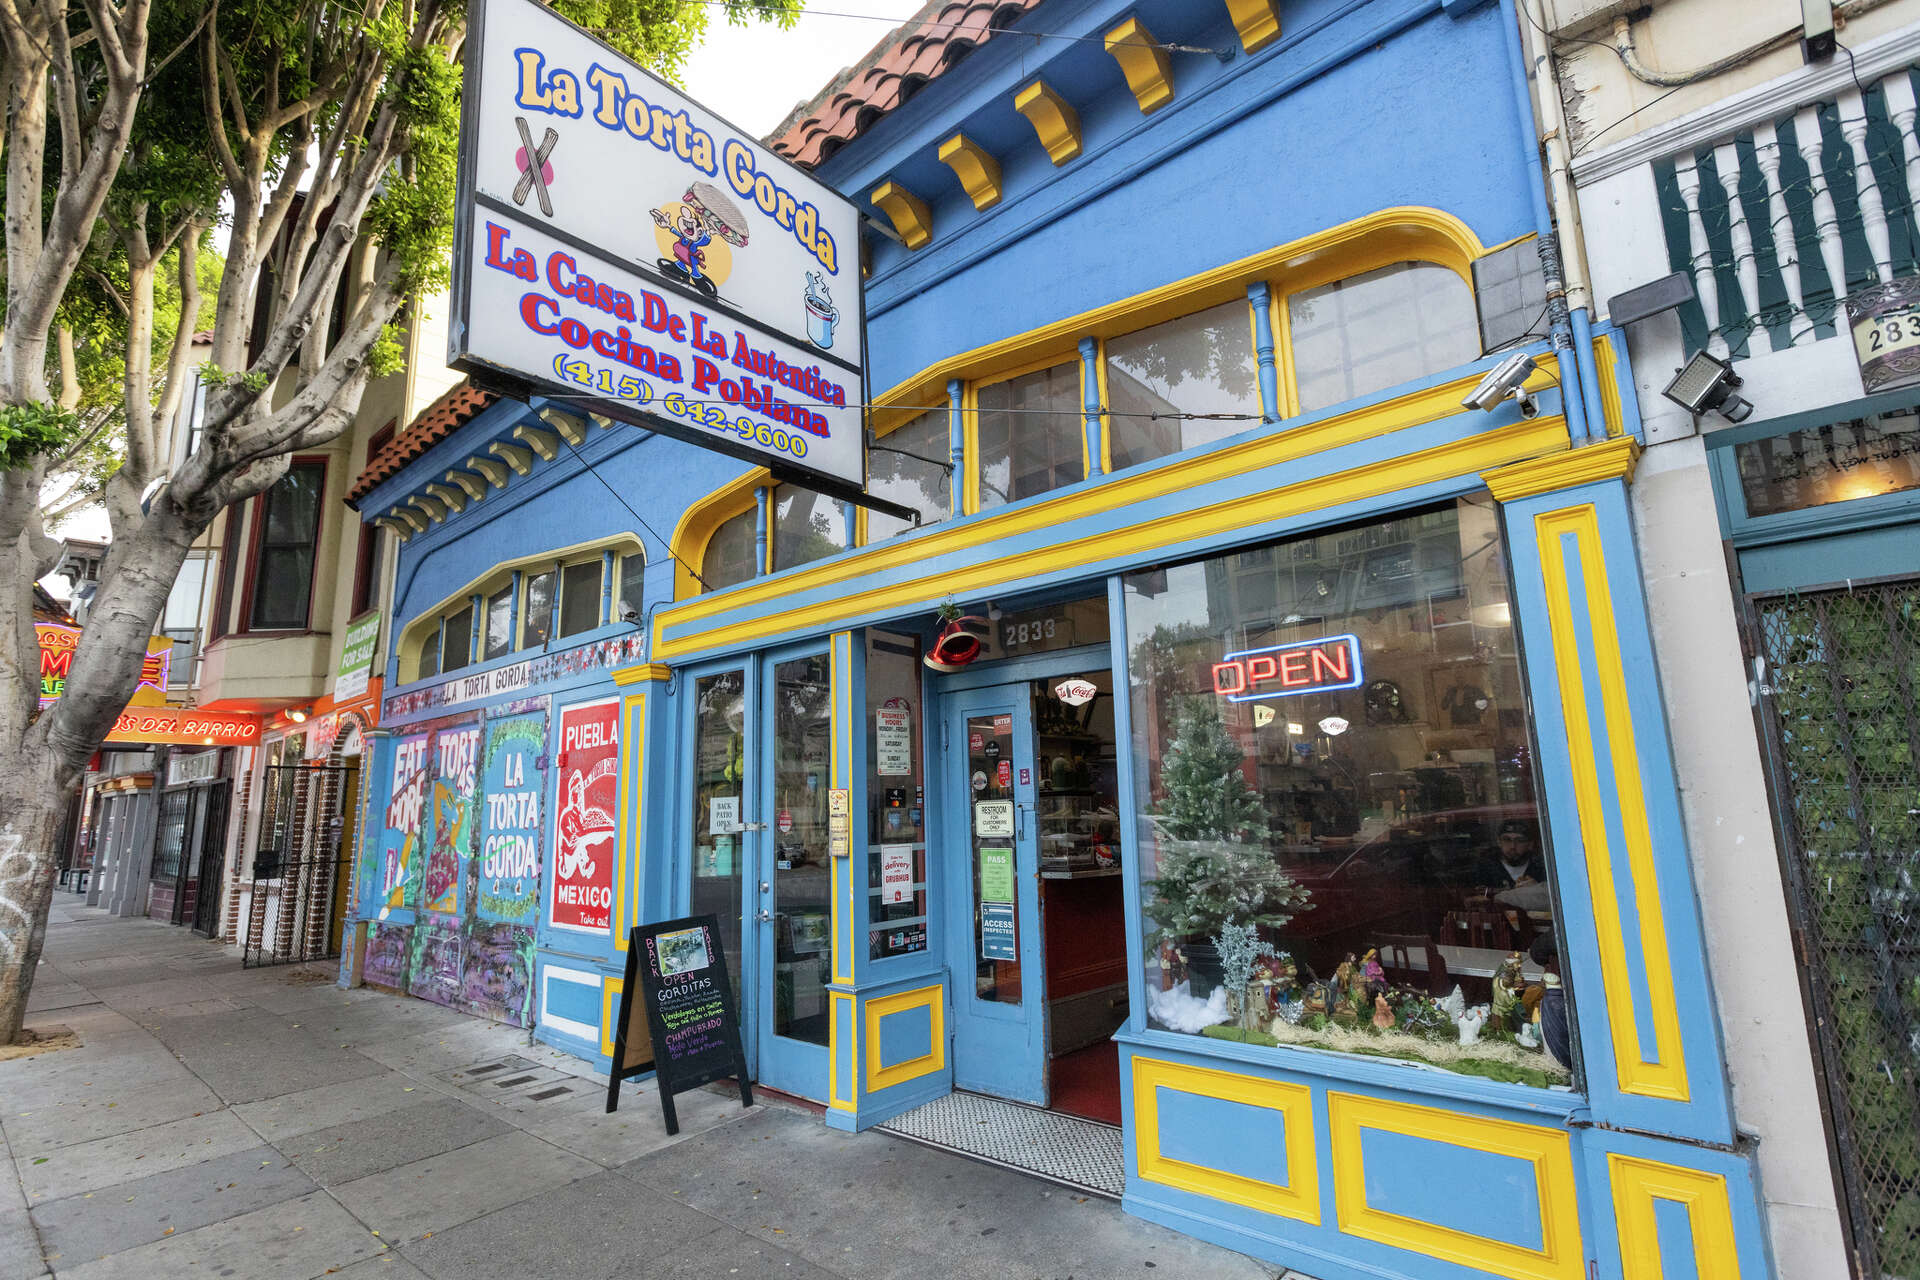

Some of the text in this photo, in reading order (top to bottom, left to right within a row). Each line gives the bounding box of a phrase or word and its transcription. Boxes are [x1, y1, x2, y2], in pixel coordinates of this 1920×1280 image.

[514, 47, 838, 276] La Torta Gorda
[484, 221, 847, 408] La Casa De La Autentica
[519, 293, 831, 439] Cocina Poblana
[552, 353, 807, 459] (415) 642-9600
[1006, 619, 1055, 646] 2833
[445, 664, 526, 702] LA TORTA GORDA
[1212, 645, 1348, 694] OPEN
[140, 718, 178, 734] DEL
[182, 720, 256, 738] BARRIO
[566, 720, 618, 751] PUEBLA
[392, 740, 427, 799] EAT
[504, 752, 524, 787] LA
[487, 791, 538, 830] TORTA
[982, 805, 1007, 814] RESTROOM
[484, 835, 537, 879] GORDA
[885, 861, 910, 871] delivery
[987, 856, 1006, 864] PASS
[885, 874, 909, 883] GRUBHUB
[558, 885, 611, 909] MEXICO
[580, 912, 608, 927] Take out
[984, 920, 1012, 929] ACCESS
[646, 938, 659, 977] BACK
[658, 978, 711, 1001] GORDITAS
[664, 972, 695, 986] OPEN
